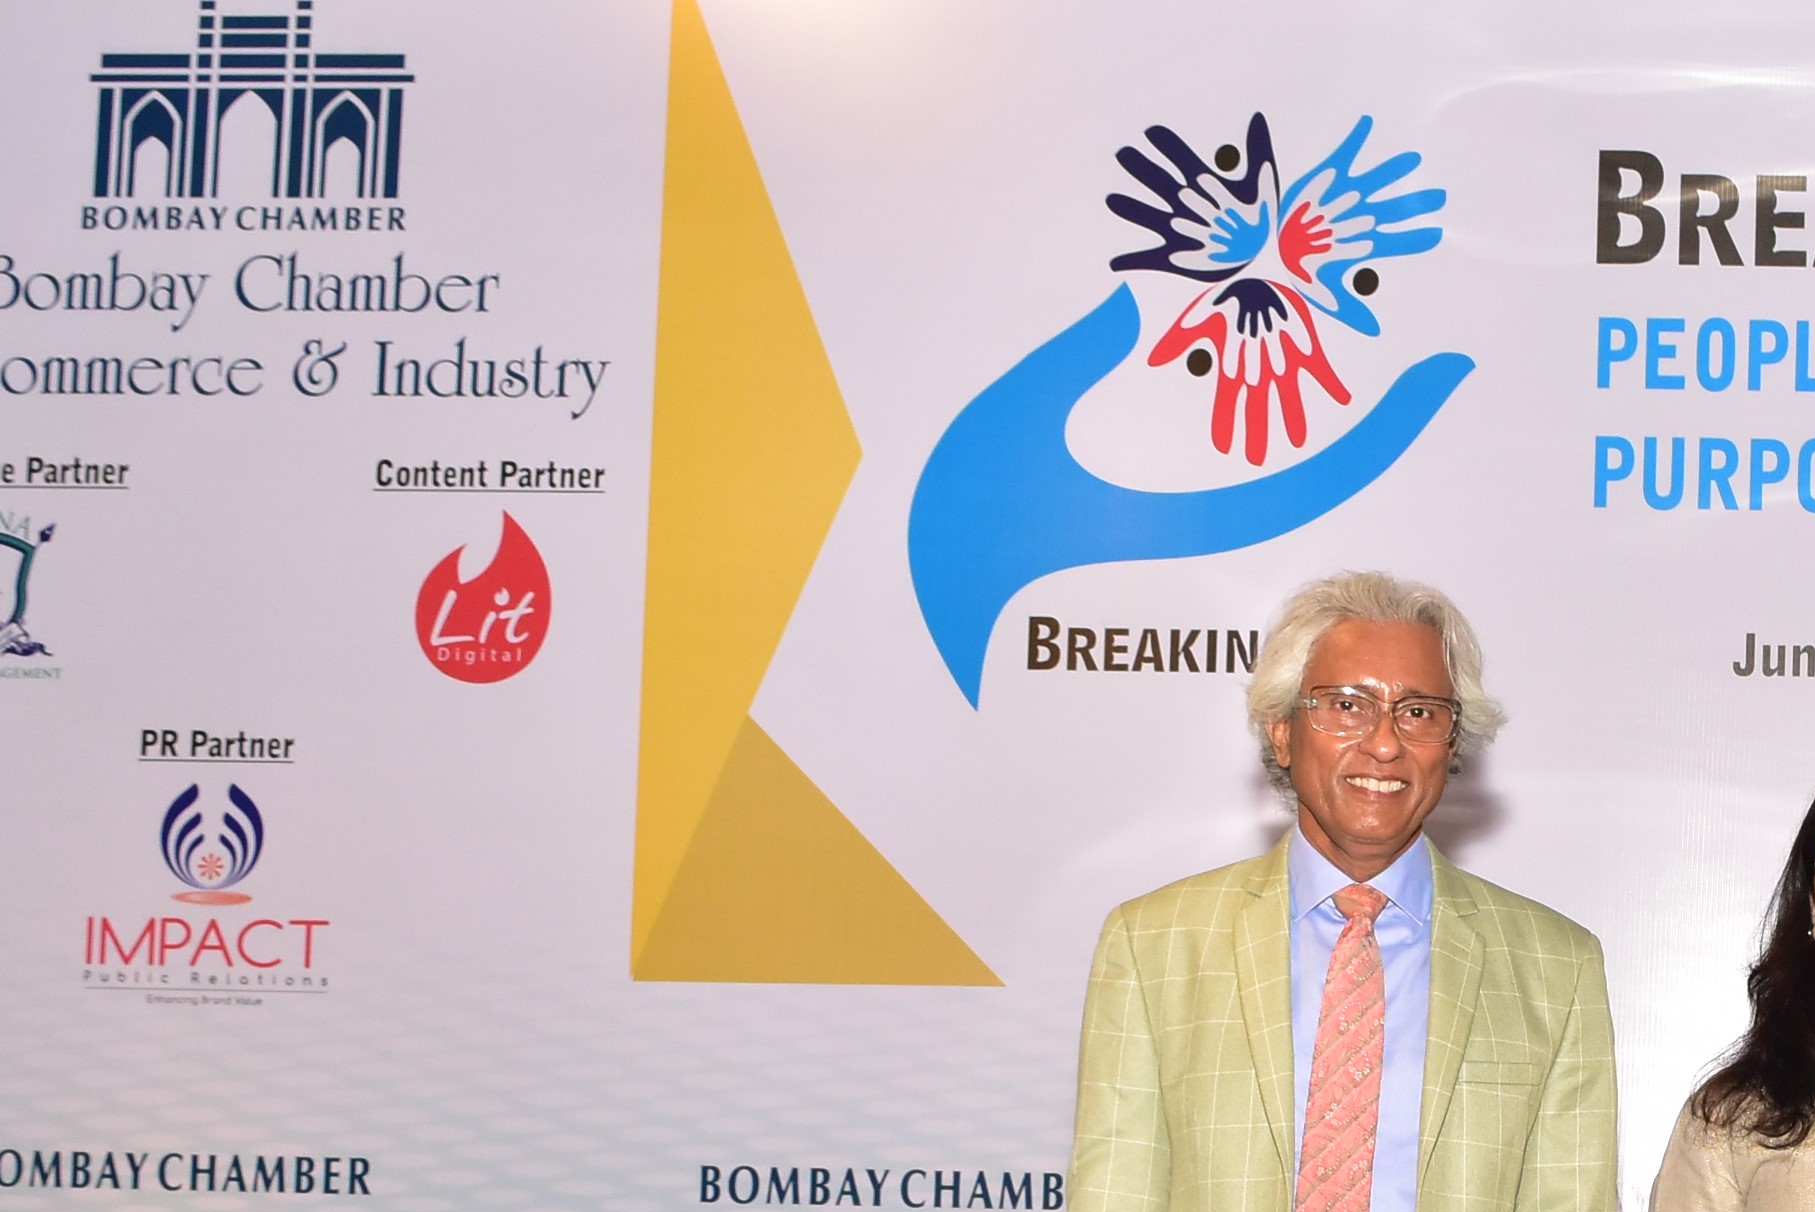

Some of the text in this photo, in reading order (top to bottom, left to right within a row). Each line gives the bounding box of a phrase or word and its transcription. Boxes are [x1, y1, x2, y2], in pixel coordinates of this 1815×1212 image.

[235, 254, 499, 312] Chamber
[0, 338, 608, 419] ommerce & Industry
[27, 457, 128, 484] Partner
[375, 459, 605, 493] Content Partner
[430, 589, 535, 645] Lit
[437, 646, 523, 663] Digital
[1027, 615, 1258, 673] BREAKIN
[141, 730, 294, 760] PR Partner
[85, 917, 329, 969] IMPACT
[83, 969, 328, 987] Public Relations
[0, 1149, 147, 1189] OMBAY
[899, 1168, 1063, 1212] CHAMB
